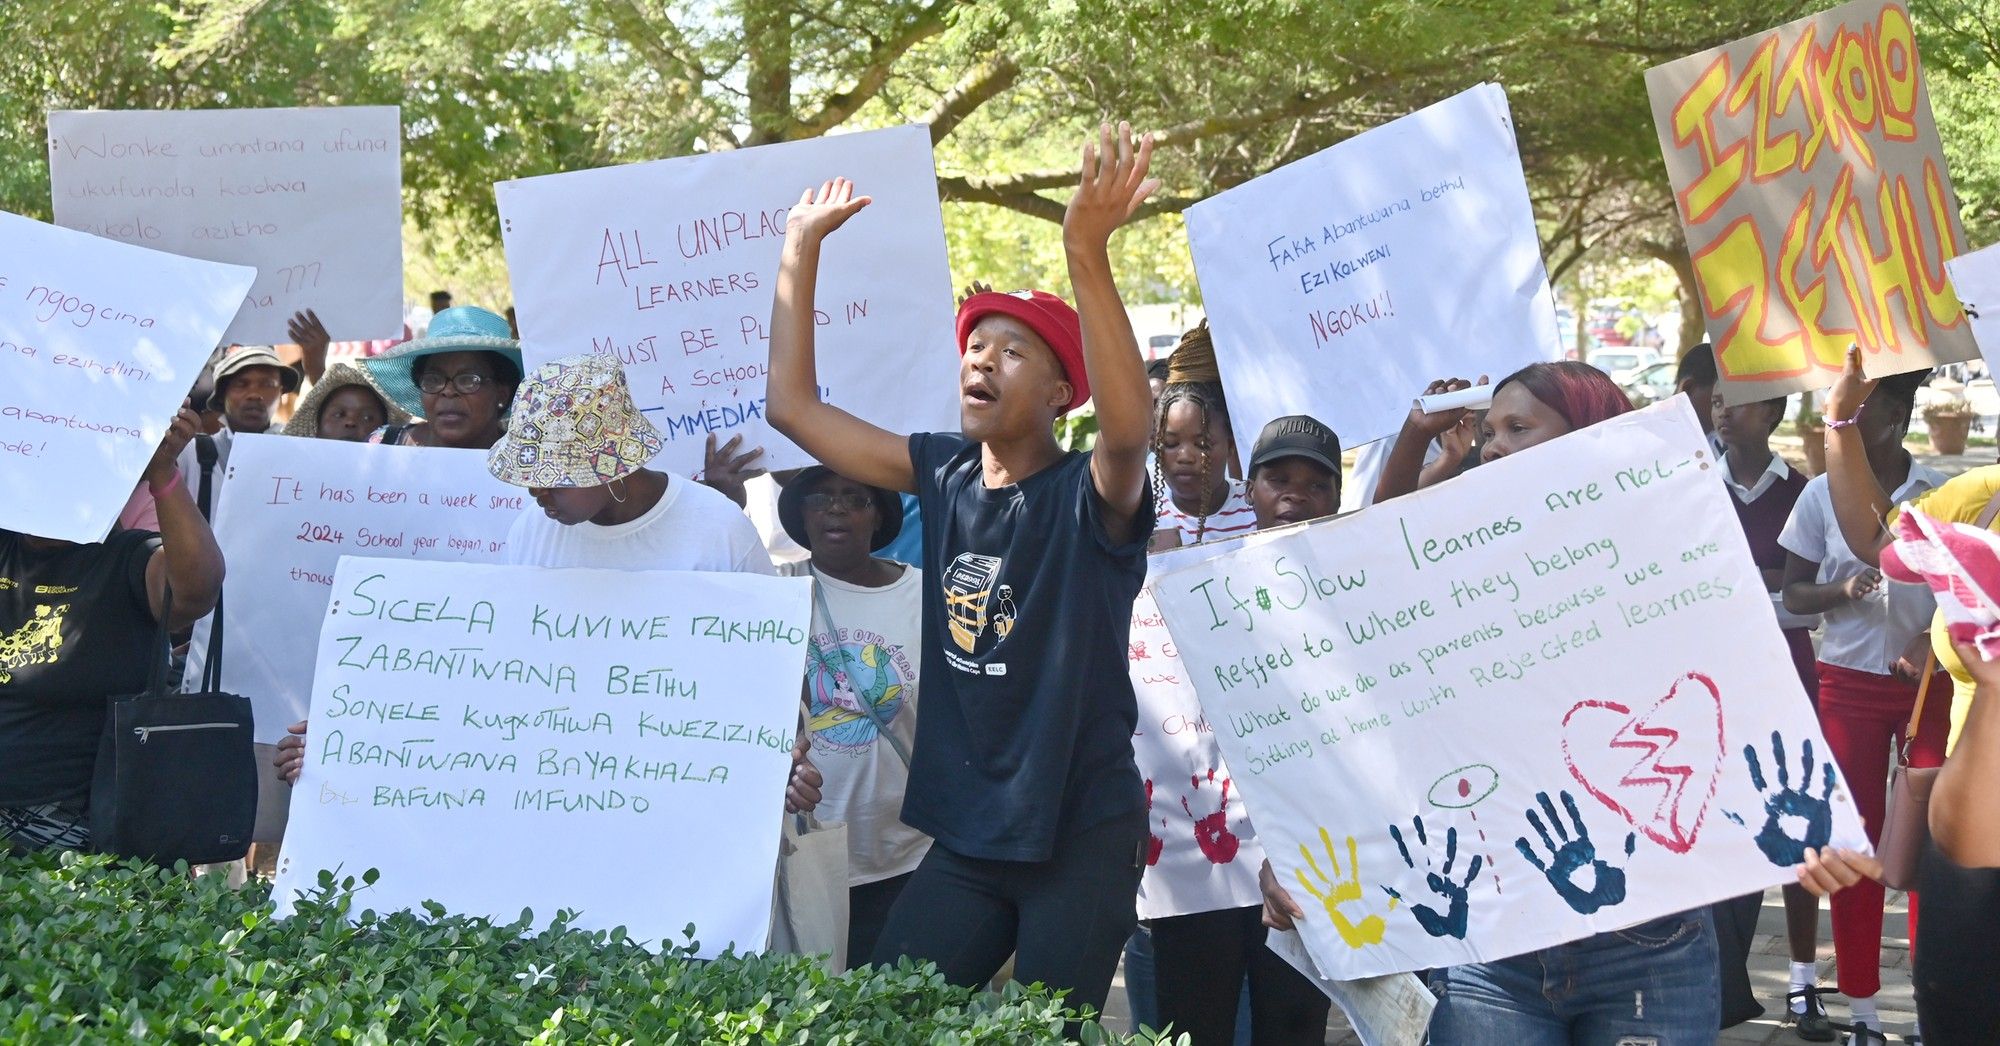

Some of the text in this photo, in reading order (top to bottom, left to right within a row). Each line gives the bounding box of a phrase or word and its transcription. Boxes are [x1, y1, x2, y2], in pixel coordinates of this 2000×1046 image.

[1671, 3, 1919, 225] IZIKOLO
[62, 134, 180, 160] Wonke
[323, 129, 386, 155] ufuna
[68, 177, 195, 199] ukufunda
[596, 207, 792, 287] ALL UNPLAC
[1692, 157, 1966, 381] ZETHU
[26, 286, 155, 327] ngogcina
[636, 272, 760, 311] LEARNERS
[681, 328, 719, 356] BE
[846, 299, 867, 325] IN
[661, 375, 676, 396] A
[2, 407, 141, 438] abantwana
[266, 476, 523, 511] It has been a week since
[296, 521, 344, 544] 2024
[356, 527, 403, 549] School
[413, 536, 439, 556] year
[1275, 556, 1366, 611] Slow
[1303, 633, 1333, 659] to
[1449, 571, 1520, 608] they
[1524, 537, 1620, 577] belong
[348, 574, 496, 634] SICELA
[532, 604, 670, 640] KUVIWE
[336, 636, 697, 700] ZABANTWANA BETHU
[853, 629, 885, 646] OUR
[886, 645, 915, 681] SEAS
[1228, 704, 1291, 738] What
[1300, 692, 1321, 714] do
[1326, 684, 1351, 703] we
[1355, 673, 1378, 693] do
[1389, 661, 1411, 678] as
[1417, 621, 1504, 675] parents
[1514, 584, 1606, 629] because
[1624, 561, 1663, 586] we
[326, 684, 441, 723] SONELE
[1320, 728, 1341, 745] at
[1345, 712, 1391, 735] home
[321, 730, 729, 784] ABANTWANA BAYAKHALA
[373, 785, 485, 810] BAFUNA
[514, 788, 650, 813] IMFUNDO
